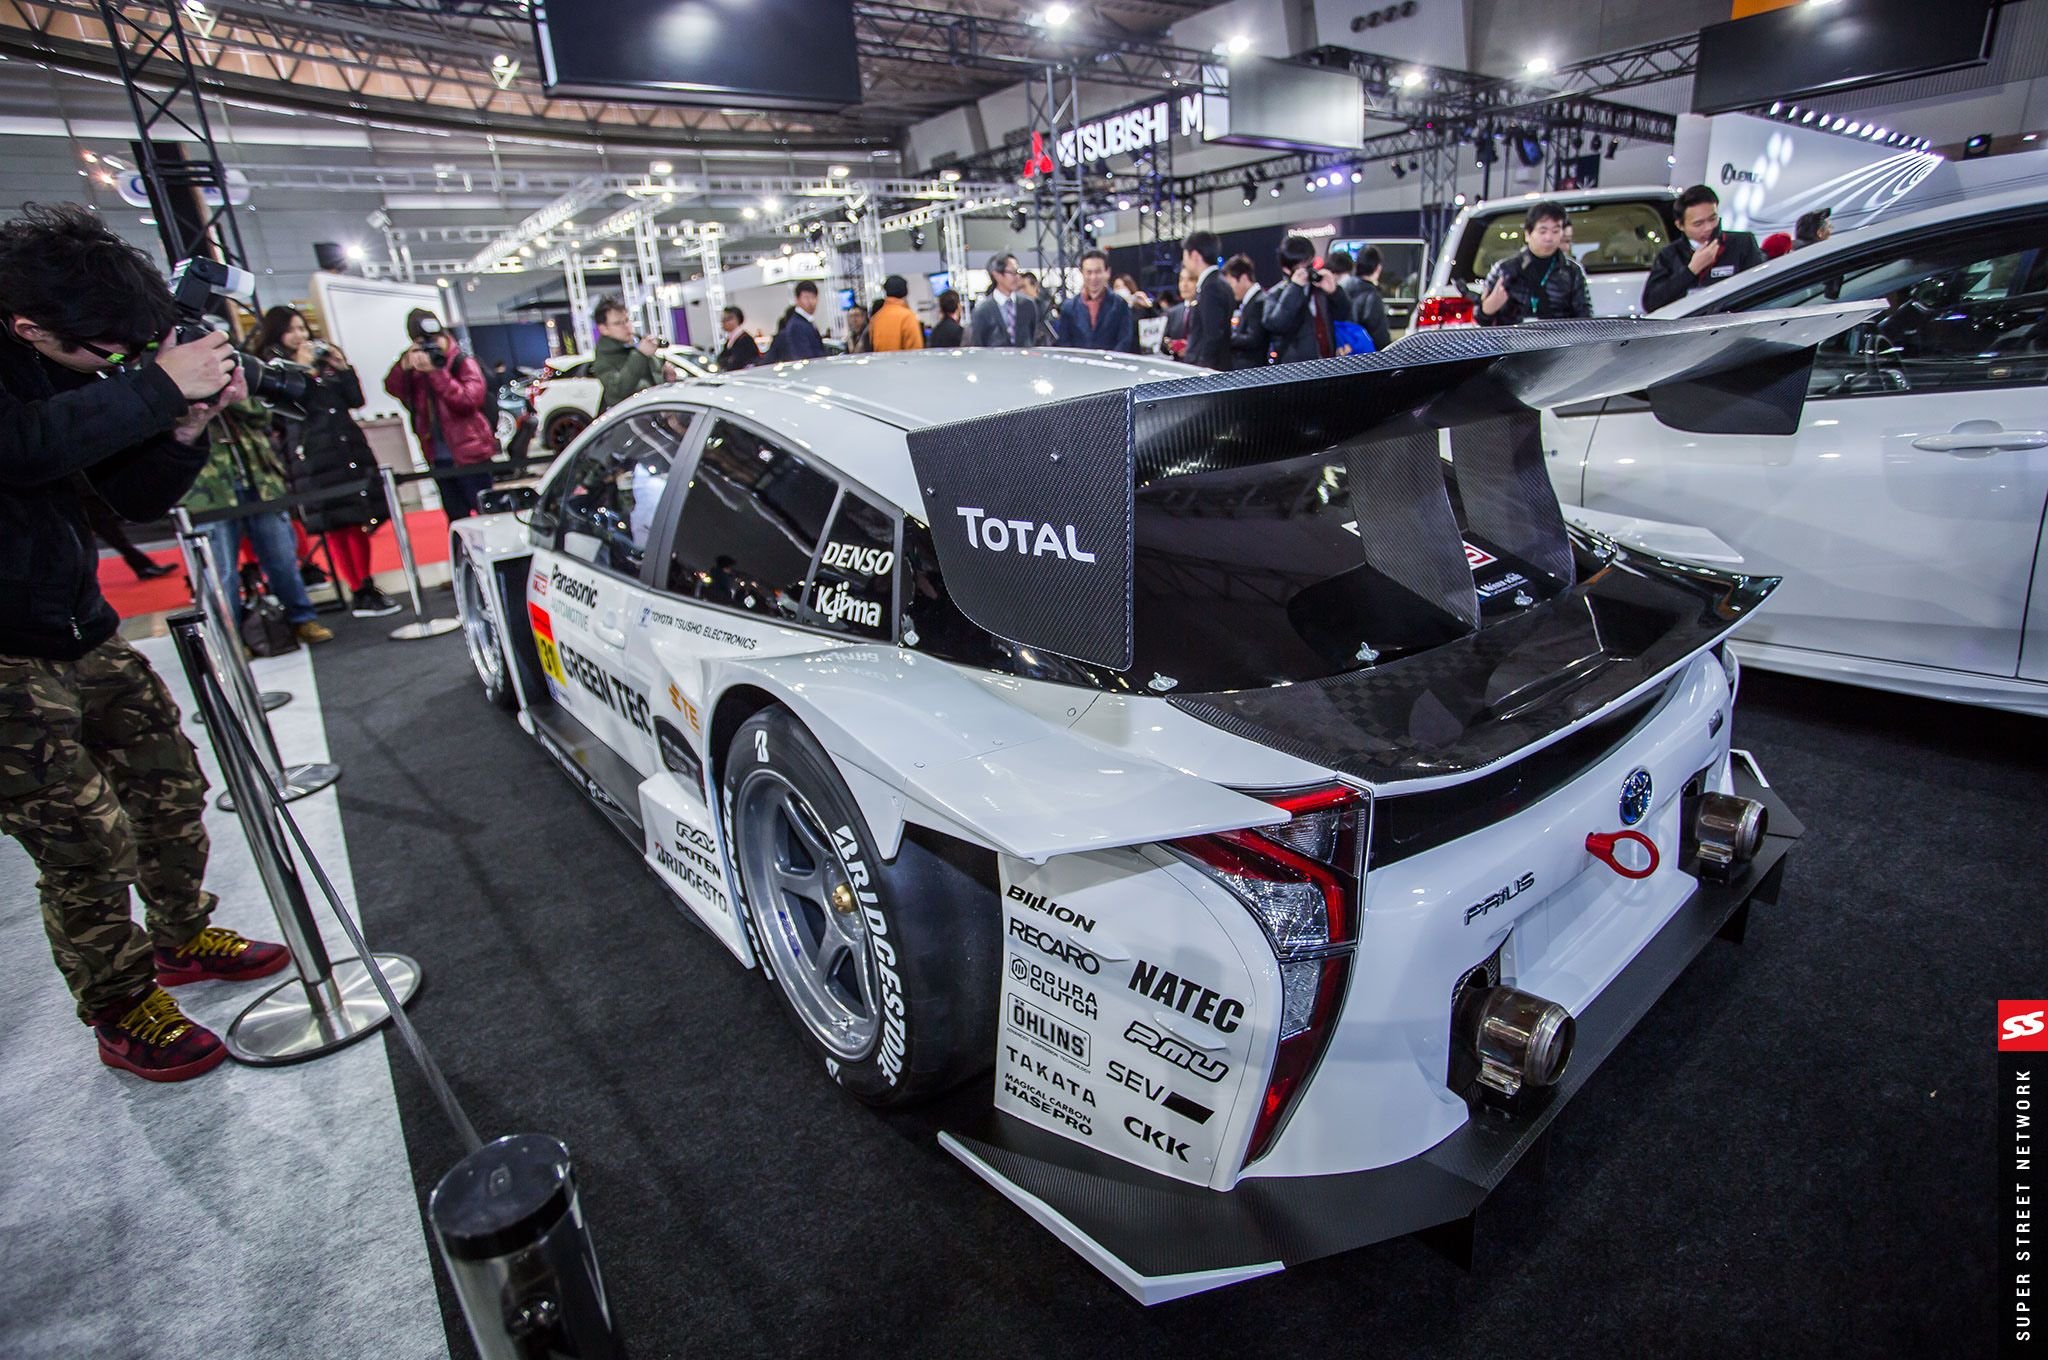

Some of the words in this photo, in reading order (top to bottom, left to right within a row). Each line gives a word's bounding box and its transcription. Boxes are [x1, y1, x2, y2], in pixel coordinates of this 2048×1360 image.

[821, 541, 895, 576] DENSO
[956, 506, 1096, 564] TOTAL
[552, 563, 598, 609] Panasonic
[651, 611, 673, 627] TOYOTA
[674, 617, 702, 635] TSUSHO
[703, 626, 757, 651] ELECTRONICS
[559, 640, 615, 711] GREEN
[610, 673, 653, 737] TEC
[655, 841, 731, 918] BRIDGESTO
[1463, 869, 1536, 926] PRIUS
[1006, 884, 1096, 934] BILLION
[831, 824, 906, 1087] BRIDGESTONE
[1009, 916, 1101, 975] RECARO
[1030, 977, 1098, 1021] CLUTCH
[1031, 964, 1098, 1007] OGURA
[1128, 959, 1245, 1034] NATEC
[1014, 998, 1085, 1058] ÖHLINS
[1005, 1072, 1046, 1100] MAGICAL
[1049, 1097, 1092, 1124] CARBON
[1006, 1044, 1096, 1108] TAKATA
[1106, 1060, 1165, 1102] SEV
[1004, 1081, 1093, 1136] HASEPRO
[1123, 1115, 1192, 1164] CKK
